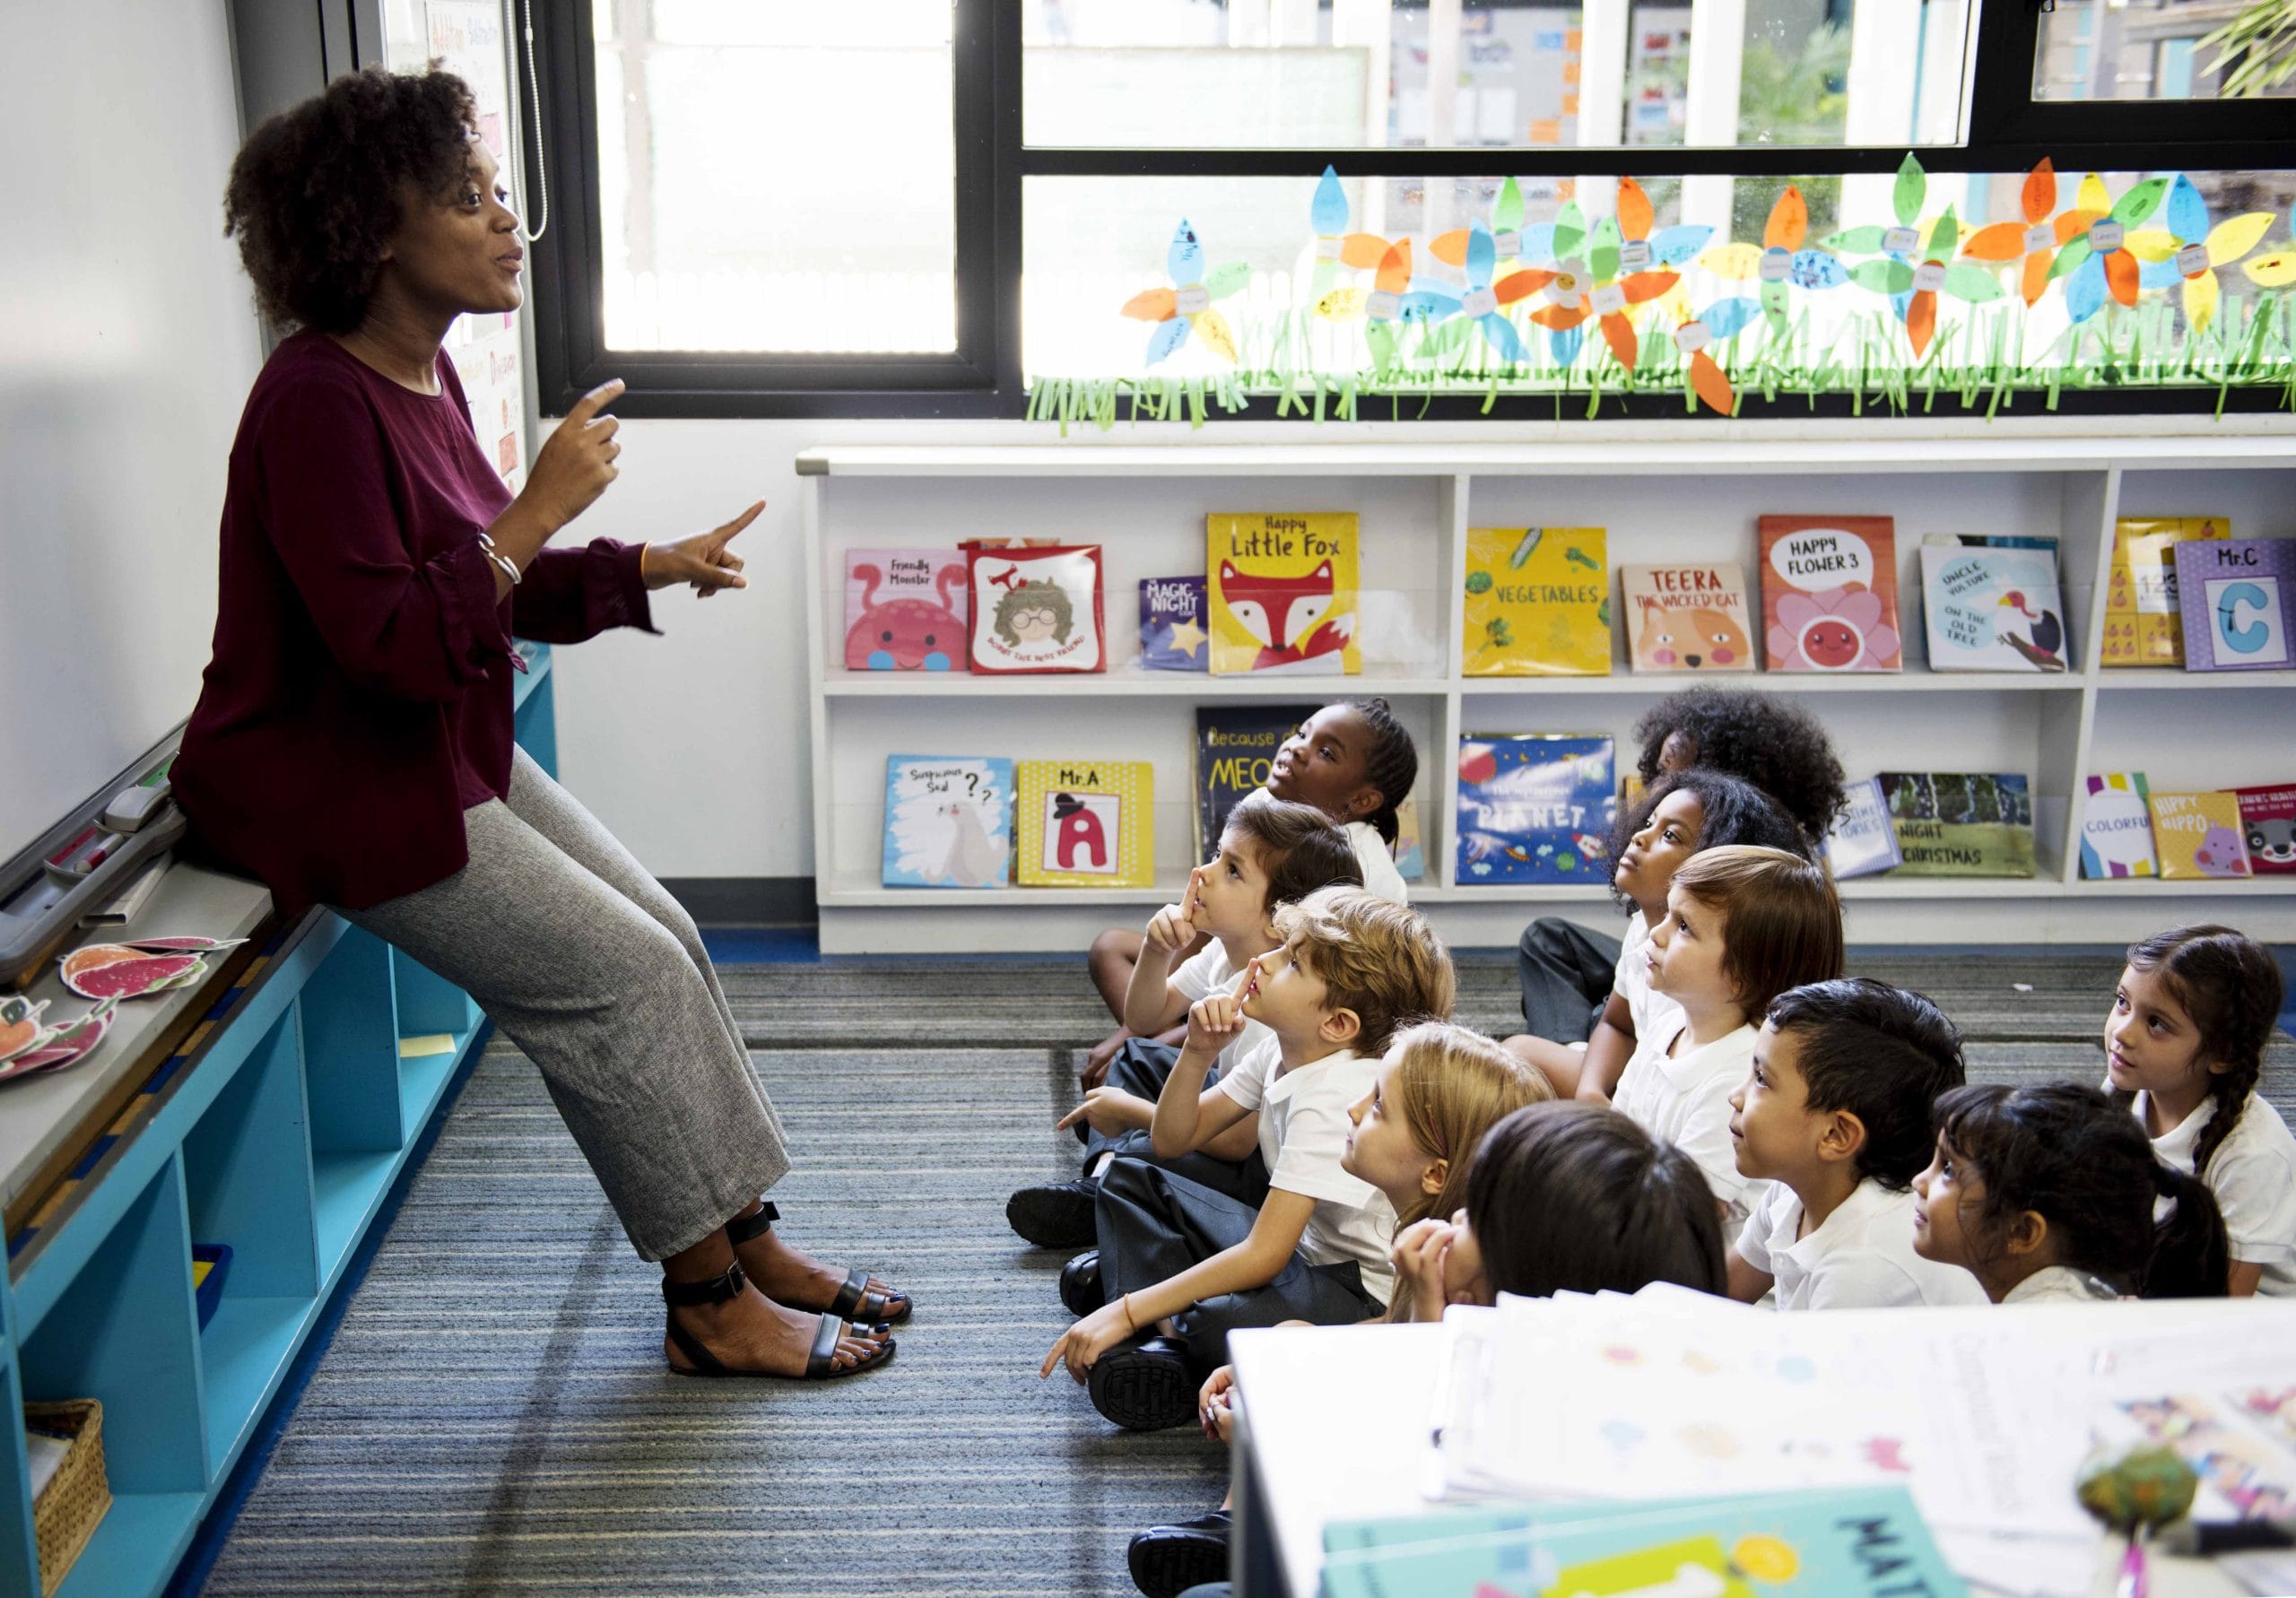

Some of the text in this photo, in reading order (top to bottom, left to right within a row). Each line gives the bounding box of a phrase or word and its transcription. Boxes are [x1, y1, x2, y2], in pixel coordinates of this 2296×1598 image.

[1265, 515, 1308, 534] Happy
[1231, 531, 1340, 557] Little Fox
[1790, 535, 1837, 555] HAPPY
[891, 559, 929, 574] Friendly
[1788, 552, 1858, 576] FLOWER 3
[1943, 560, 1981, 585] UNCLE
[890, 574, 930, 586] Monster
[1649, 569, 1723, 592] TEERA
[1948, 570, 1989, 596] VULTURE
[1147, 583, 1193, 598] MAGIC
[1496, 585, 1599, 604] VEGETABLES
[1661, 593, 1711, 607] WICKED
[1716, 592, 1738, 607] CAT
[1152, 596, 1198, 612] NIGHT
[1944, 605, 1986, 625] ON THE
[1951, 620, 1978, 633] OLD
[1947, 630, 1979, 647] TREE
[1034, 653, 1056, 662] BEST
[1208, 726, 1275, 747] Because
[909, 769, 962, 781] Suspicious
[1208, 758, 1272, 791] MEO
[927, 780, 949, 794] Seal
[2154, 795, 2197, 816] HIPPY
[1478, 801, 1586, 832] PLANET
[2086, 816, 2149, 833] COLORFU
[2161, 813, 2208, 833] HIPPO
[1900, 824, 1943, 838] NIGHT
[1903, 848, 1982, 864] CHRISTMAS
